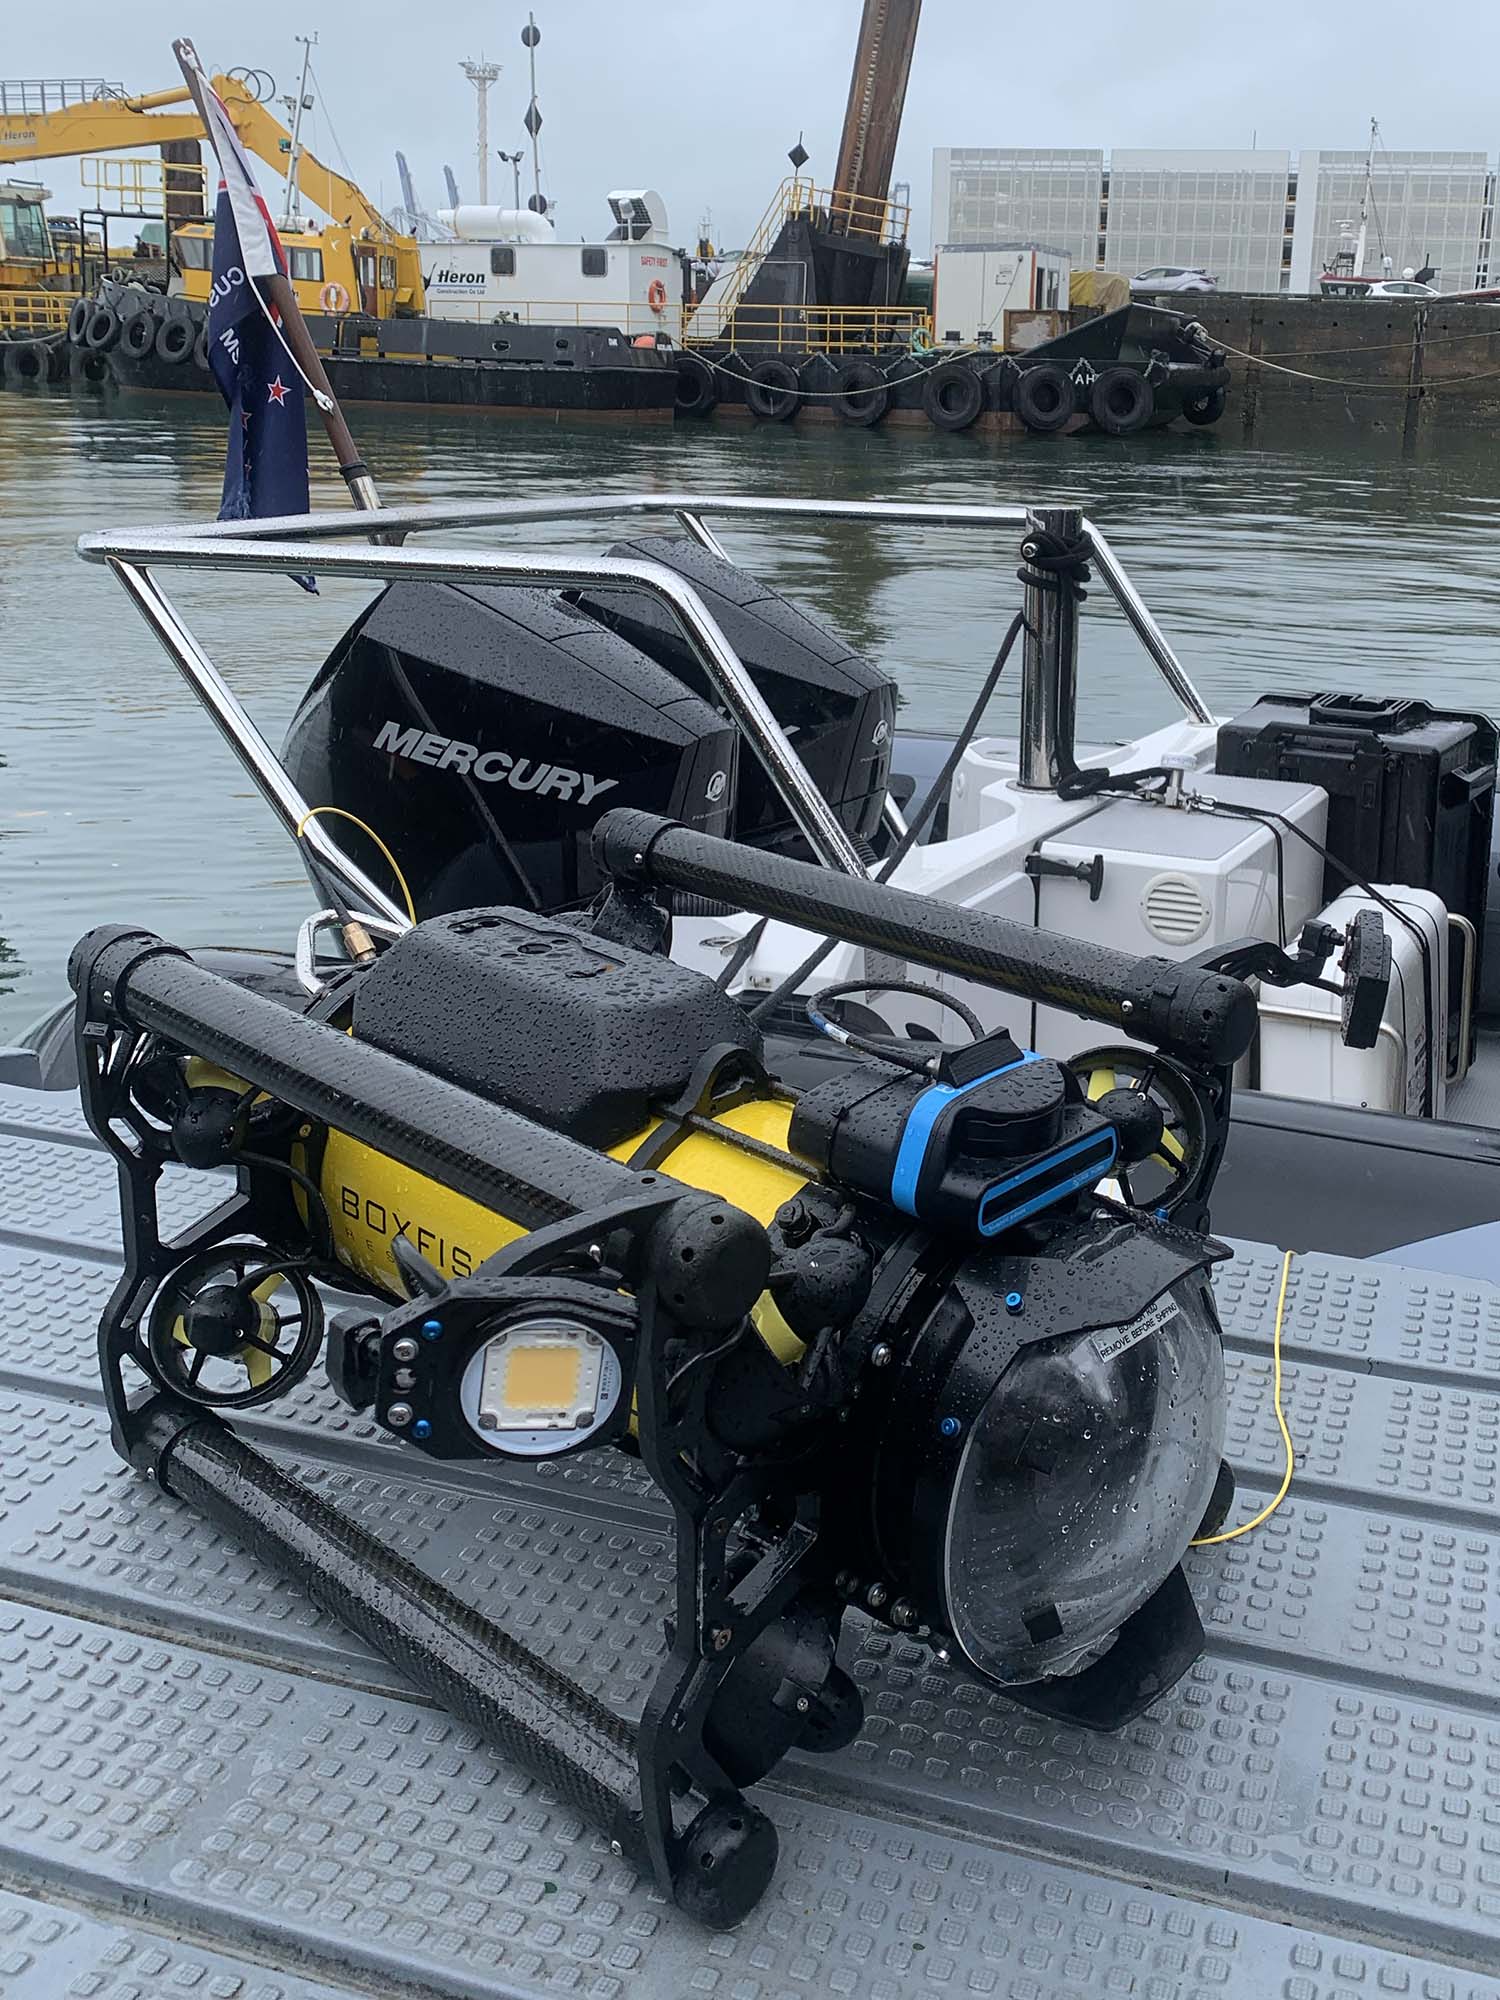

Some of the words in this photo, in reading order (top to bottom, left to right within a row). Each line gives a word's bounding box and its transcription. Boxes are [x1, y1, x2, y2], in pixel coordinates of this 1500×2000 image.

[4, 130, 35, 140] Heron
[437, 269, 486, 284] Heron
[372, 720, 620, 806] MERCURY
[341, 1185, 484, 1278] BOXFIS
[1100, 1335, 1130, 1358] REMOVE
[1131, 1318, 1155, 1339] BEFORE
[1155, 1302, 1177, 1322] SHIPPING
